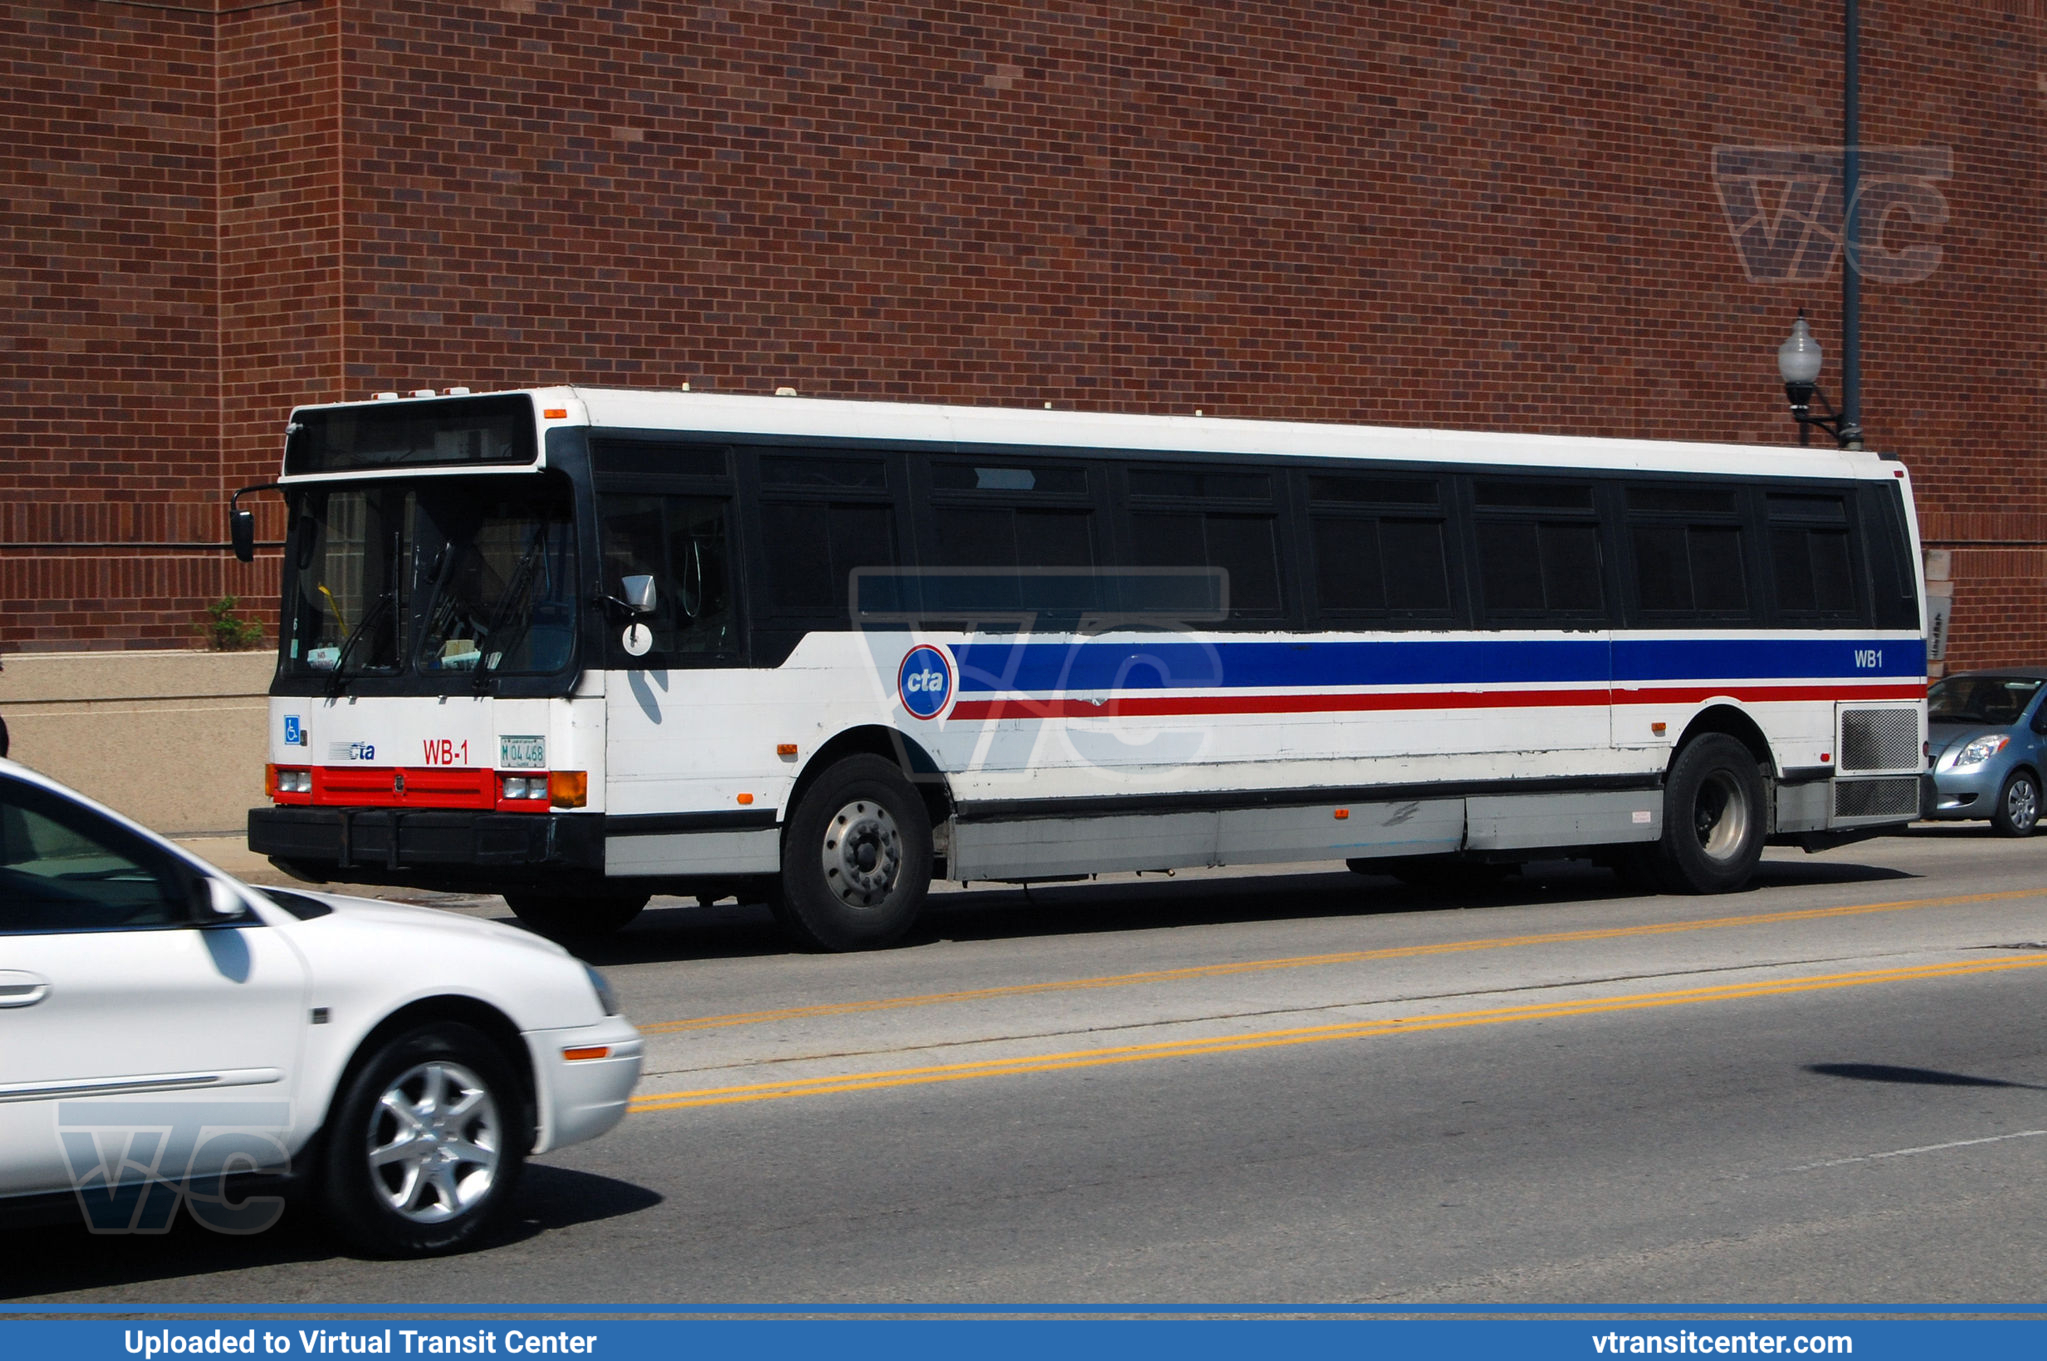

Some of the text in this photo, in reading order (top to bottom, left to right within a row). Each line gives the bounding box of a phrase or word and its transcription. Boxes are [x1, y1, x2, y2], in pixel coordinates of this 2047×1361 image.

[1854, 649, 1882, 668] WB1
[907, 668, 943, 692] cta
[423, 739, 468, 765] WB-1
[511, 744, 523, 761] 04
[525, 744, 544, 762] 468
